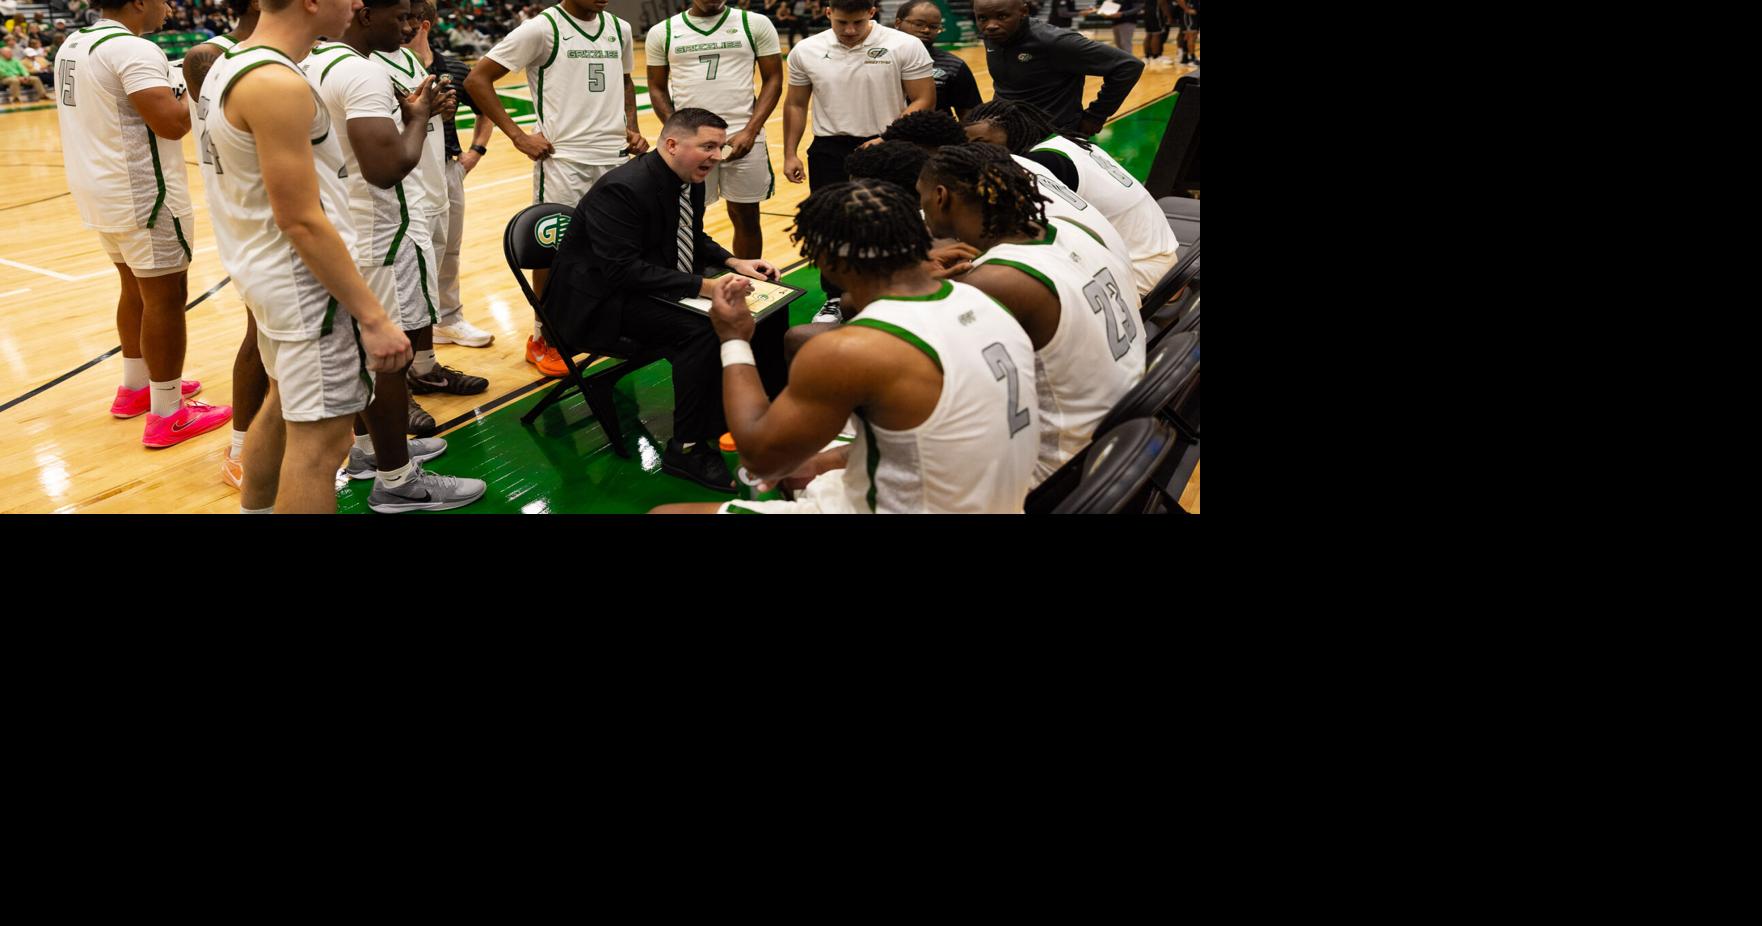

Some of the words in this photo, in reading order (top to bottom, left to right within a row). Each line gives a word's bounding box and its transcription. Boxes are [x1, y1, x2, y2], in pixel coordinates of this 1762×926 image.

[59, 59, 77, 107] 15
[588, 63, 606, 92] 5
[698, 54, 720, 80] 7
[1082, 267, 1137, 362] 23
[981, 341, 1031, 440] 2
